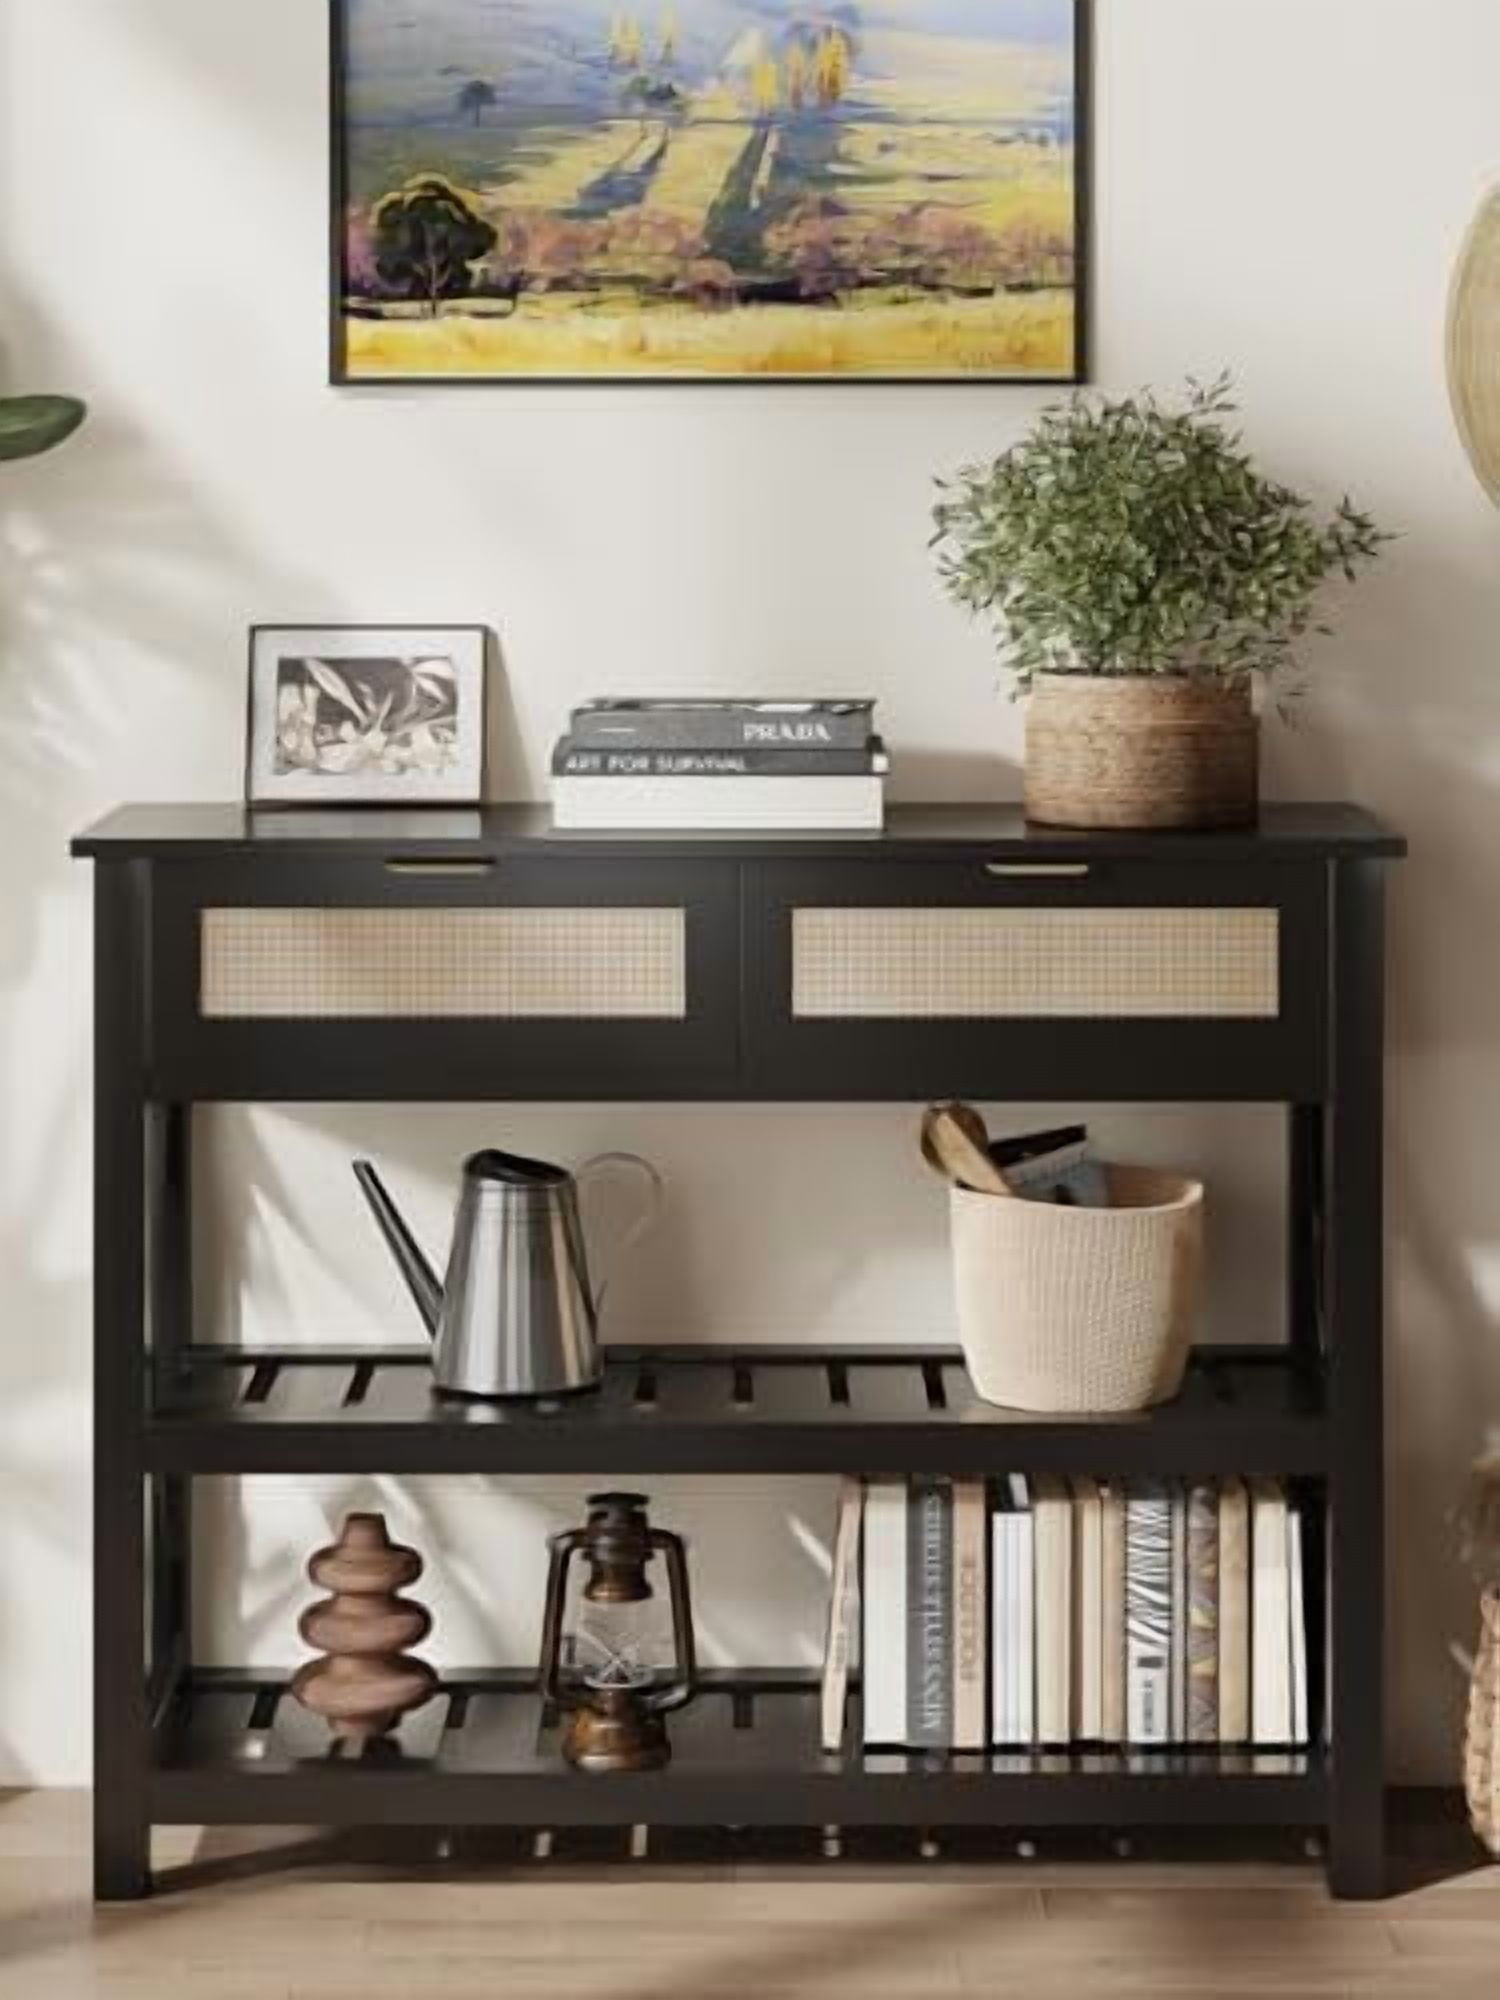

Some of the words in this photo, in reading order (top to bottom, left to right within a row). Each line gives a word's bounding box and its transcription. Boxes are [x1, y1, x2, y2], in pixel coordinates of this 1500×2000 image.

[743, 722, 831, 742] PRADA
[565, 754, 600, 771] ART
[607, 754, 649, 771] FOR
